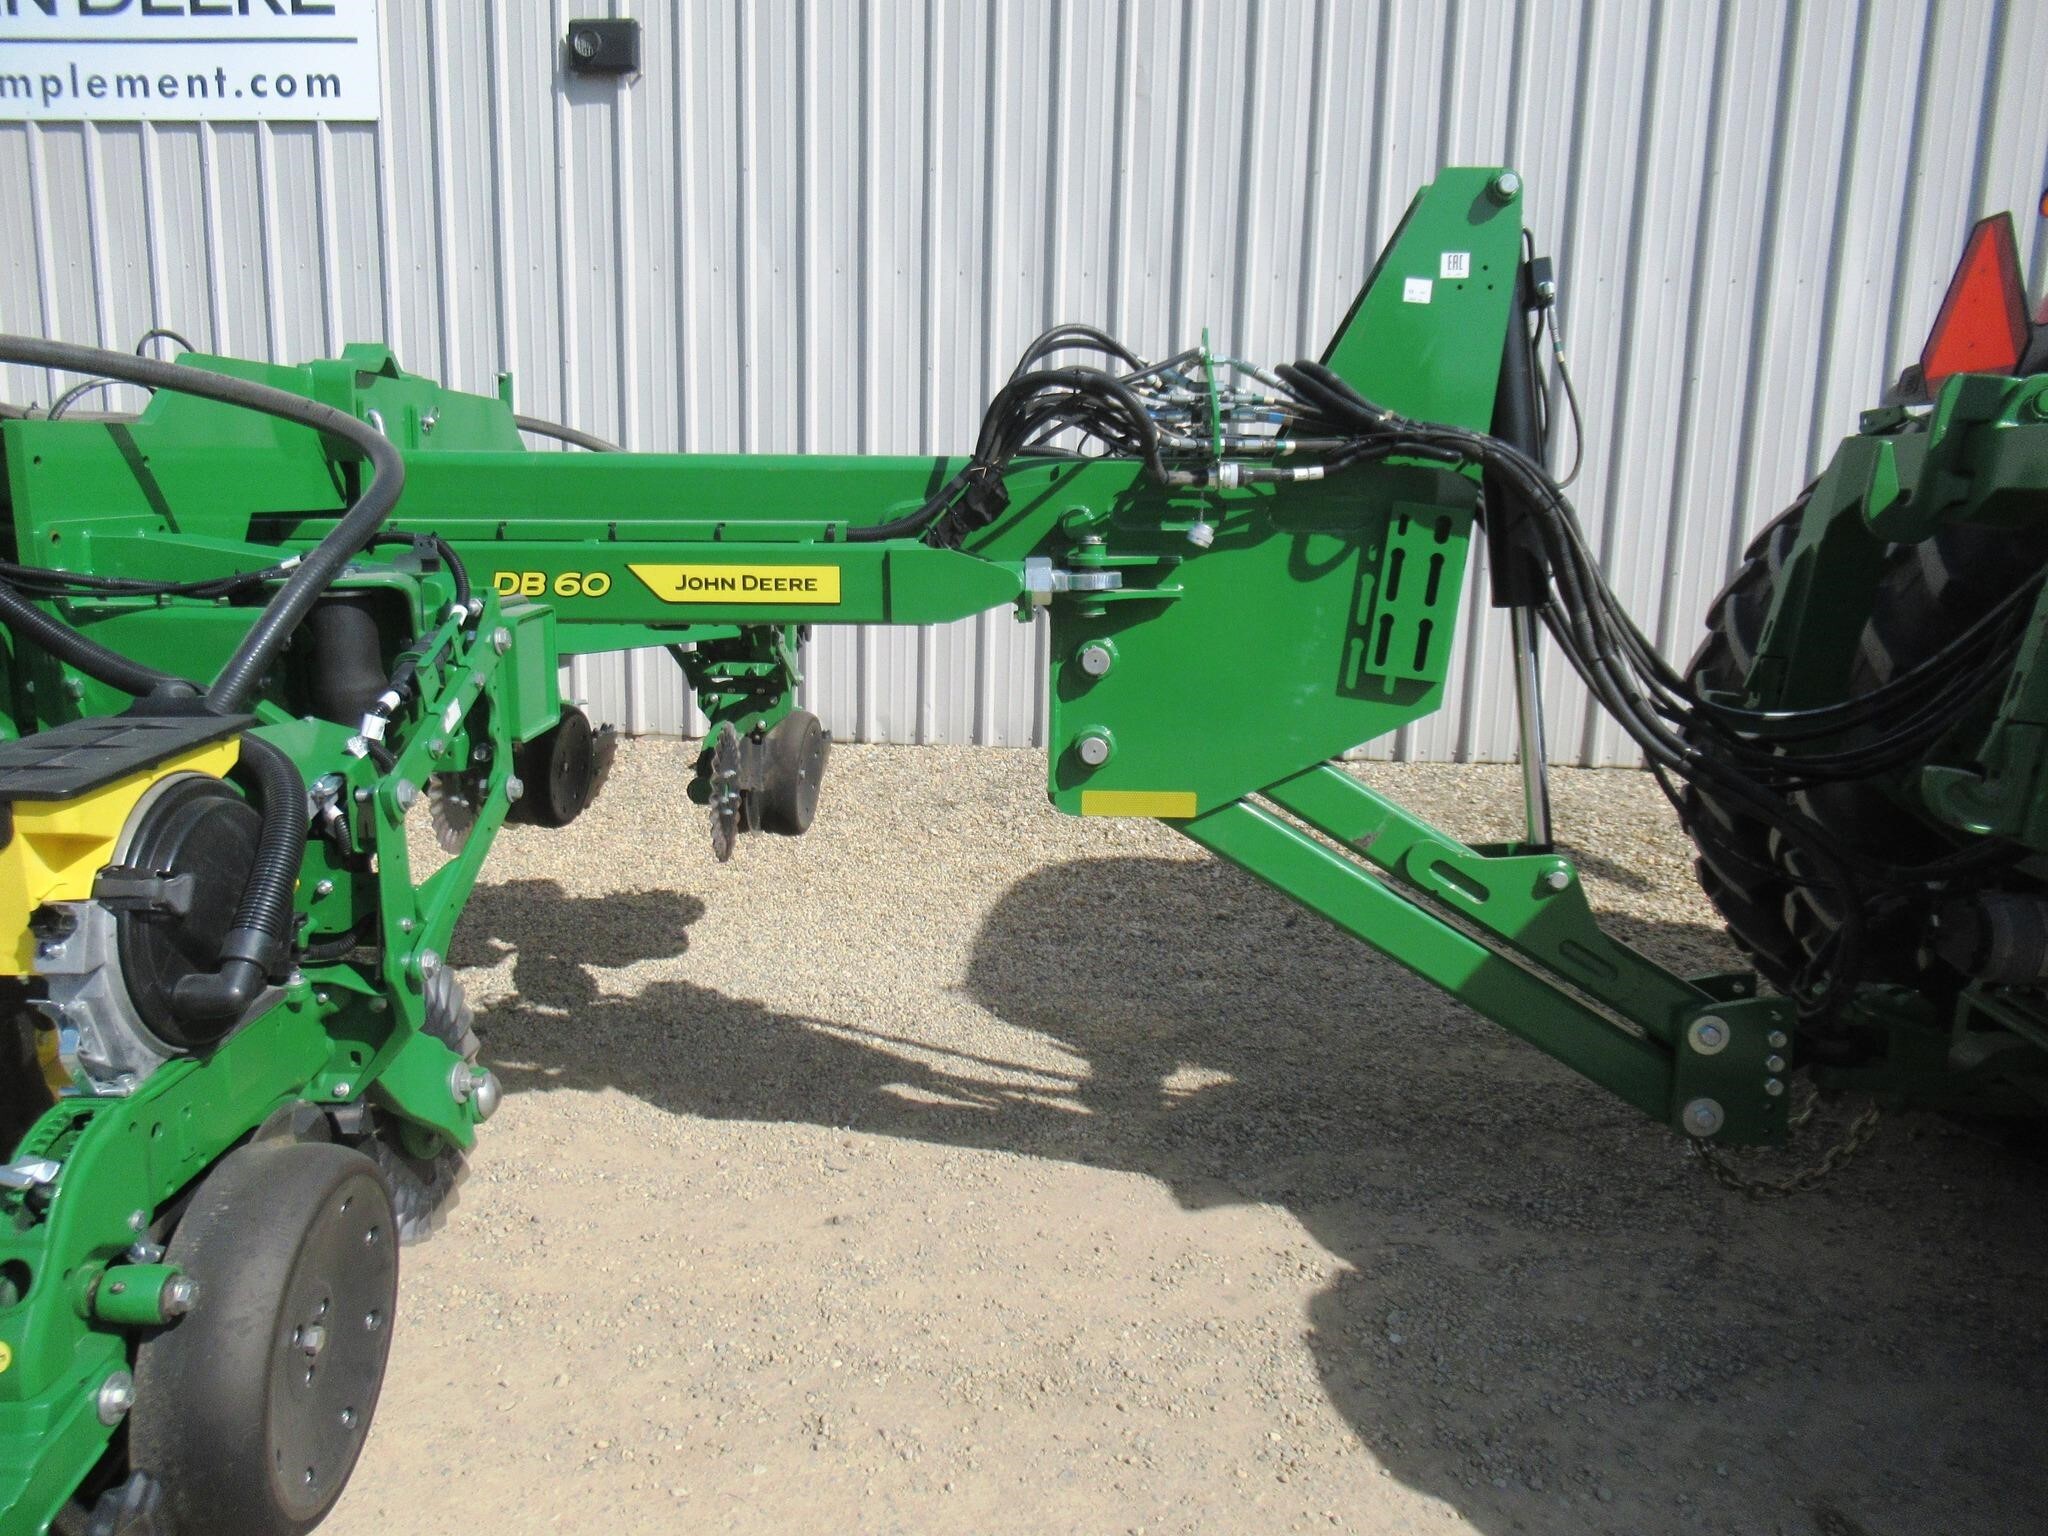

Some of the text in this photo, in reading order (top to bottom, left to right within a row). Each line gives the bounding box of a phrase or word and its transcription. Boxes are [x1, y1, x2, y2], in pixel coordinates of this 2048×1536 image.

[0, 62, 341, 108] mplement.com
[1447, 254, 1464, 271] EAC
[493, 571, 612, 598] DB 60
[675, 574, 818, 592] JOHN DEERE
